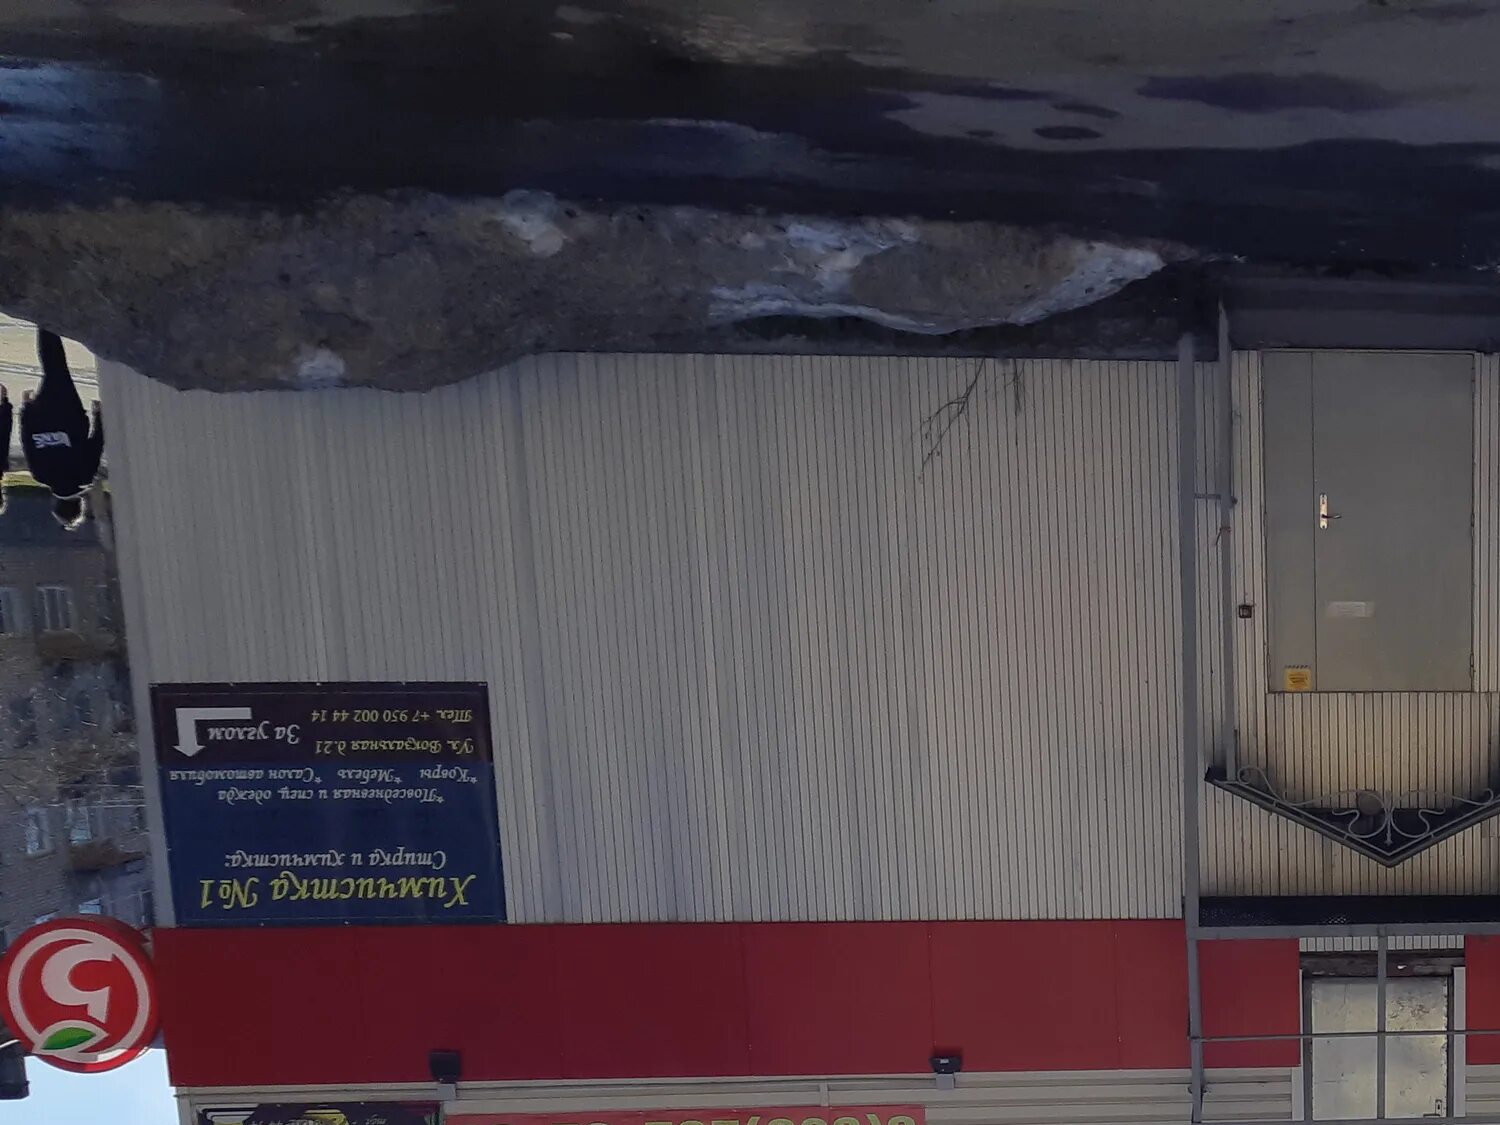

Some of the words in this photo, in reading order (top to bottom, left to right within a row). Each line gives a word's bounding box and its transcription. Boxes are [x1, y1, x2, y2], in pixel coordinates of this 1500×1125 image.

[310, 709, 328, 722] 14
[332, 709, 350, 722] 44
[354, 709, 379, 721] 002
[382, 708, 409, 721] 950
[412, 709, 430, 721] +7
[207, 720, 270, 743] углом
[273, 724, 300, 744] За
[315, 740, 347, 755] д.21
[350, 736, 442, 752] Вокзальная
[168, 769, 265, 784] автомобиля
[217, 789, 272, 805] одежда
[318, 790, 328, 801] и
[224, 850, 345, 868] химчистка:
[351, 853, 363, 866] и
[368, 847, 446, 870] Стирка
[269, 871, 476, 908] Химчистка
